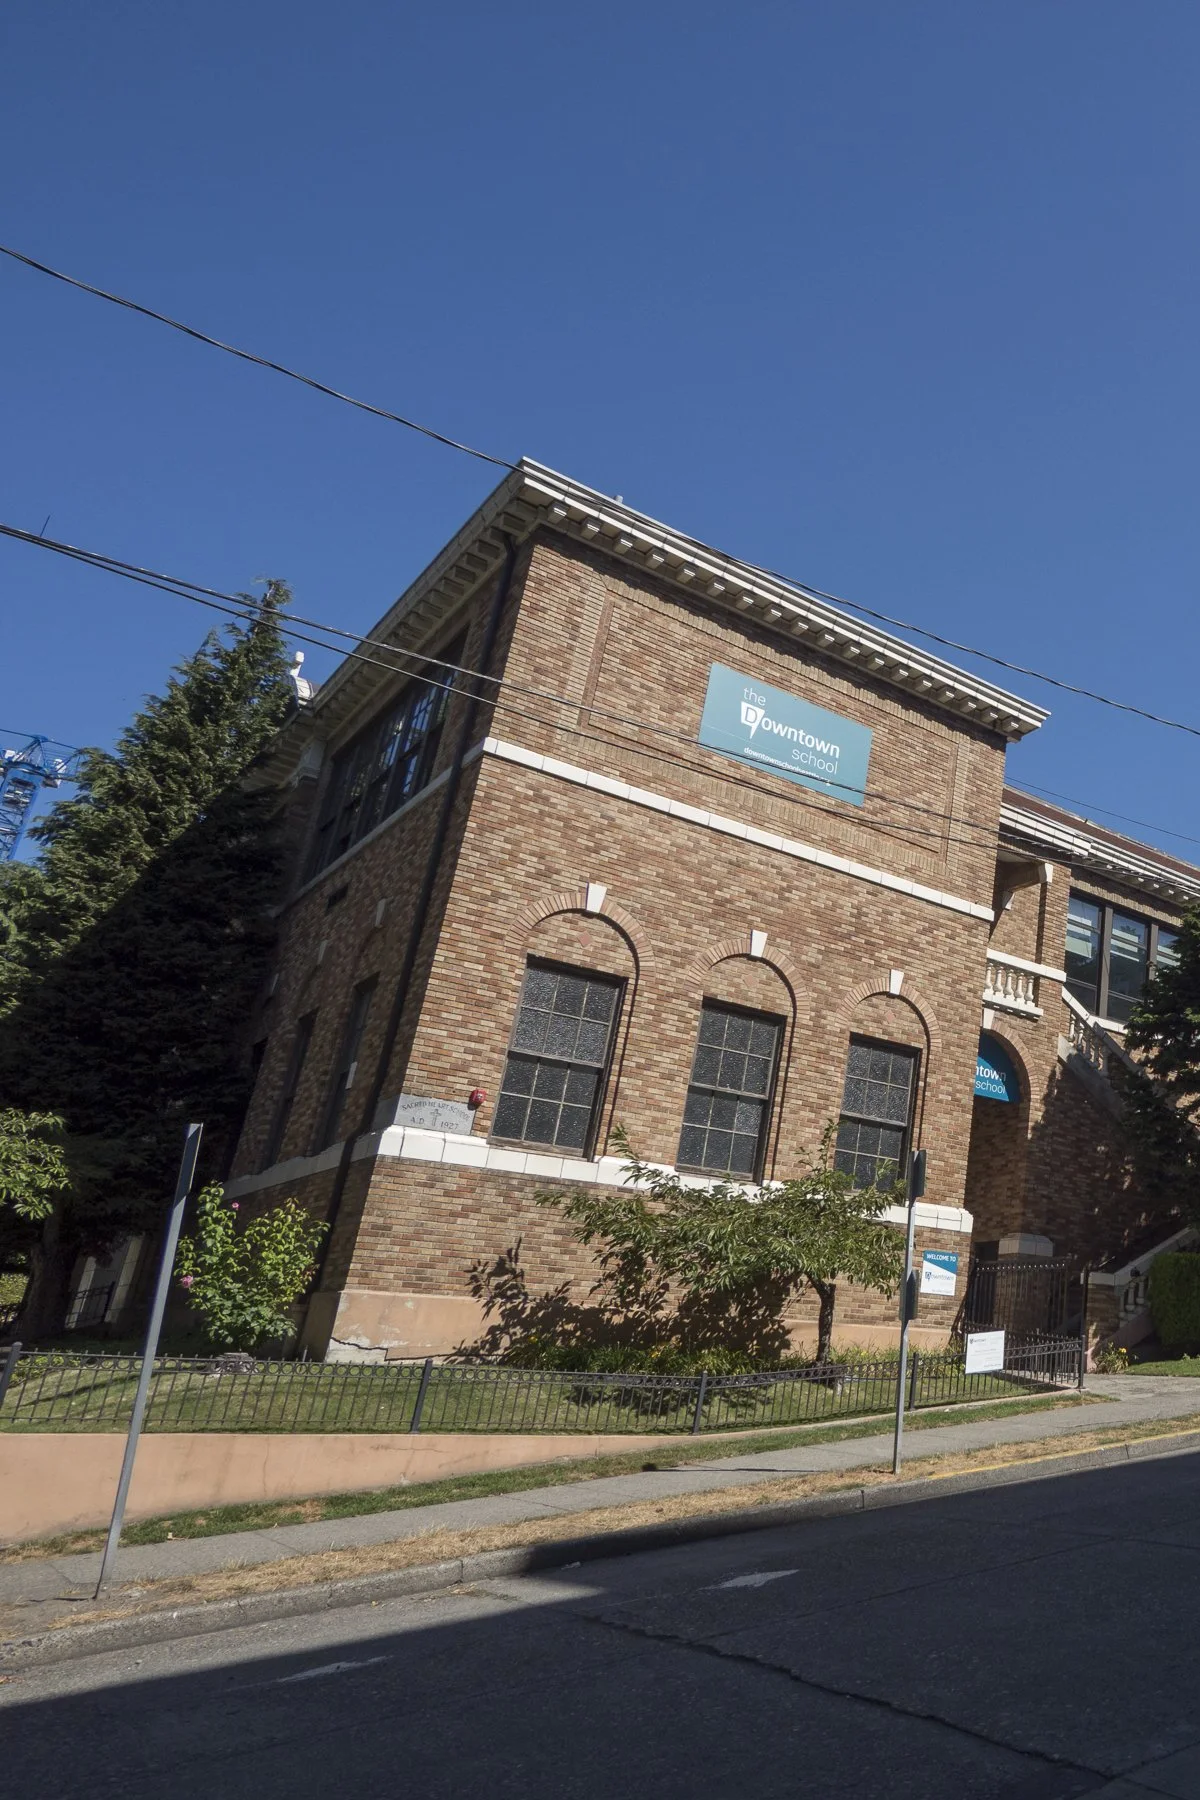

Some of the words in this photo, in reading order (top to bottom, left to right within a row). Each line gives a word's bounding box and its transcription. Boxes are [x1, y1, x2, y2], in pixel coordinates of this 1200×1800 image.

[743, 687, 766, 706] the
[741, 701, 840, 759] Downtown
[791, 748, 838, 775] school
[975, 1080, 1006, 1094] school
[440, 1121, 459, 1130] 1927
[926, 1253, 949, 1262] WELCOME
